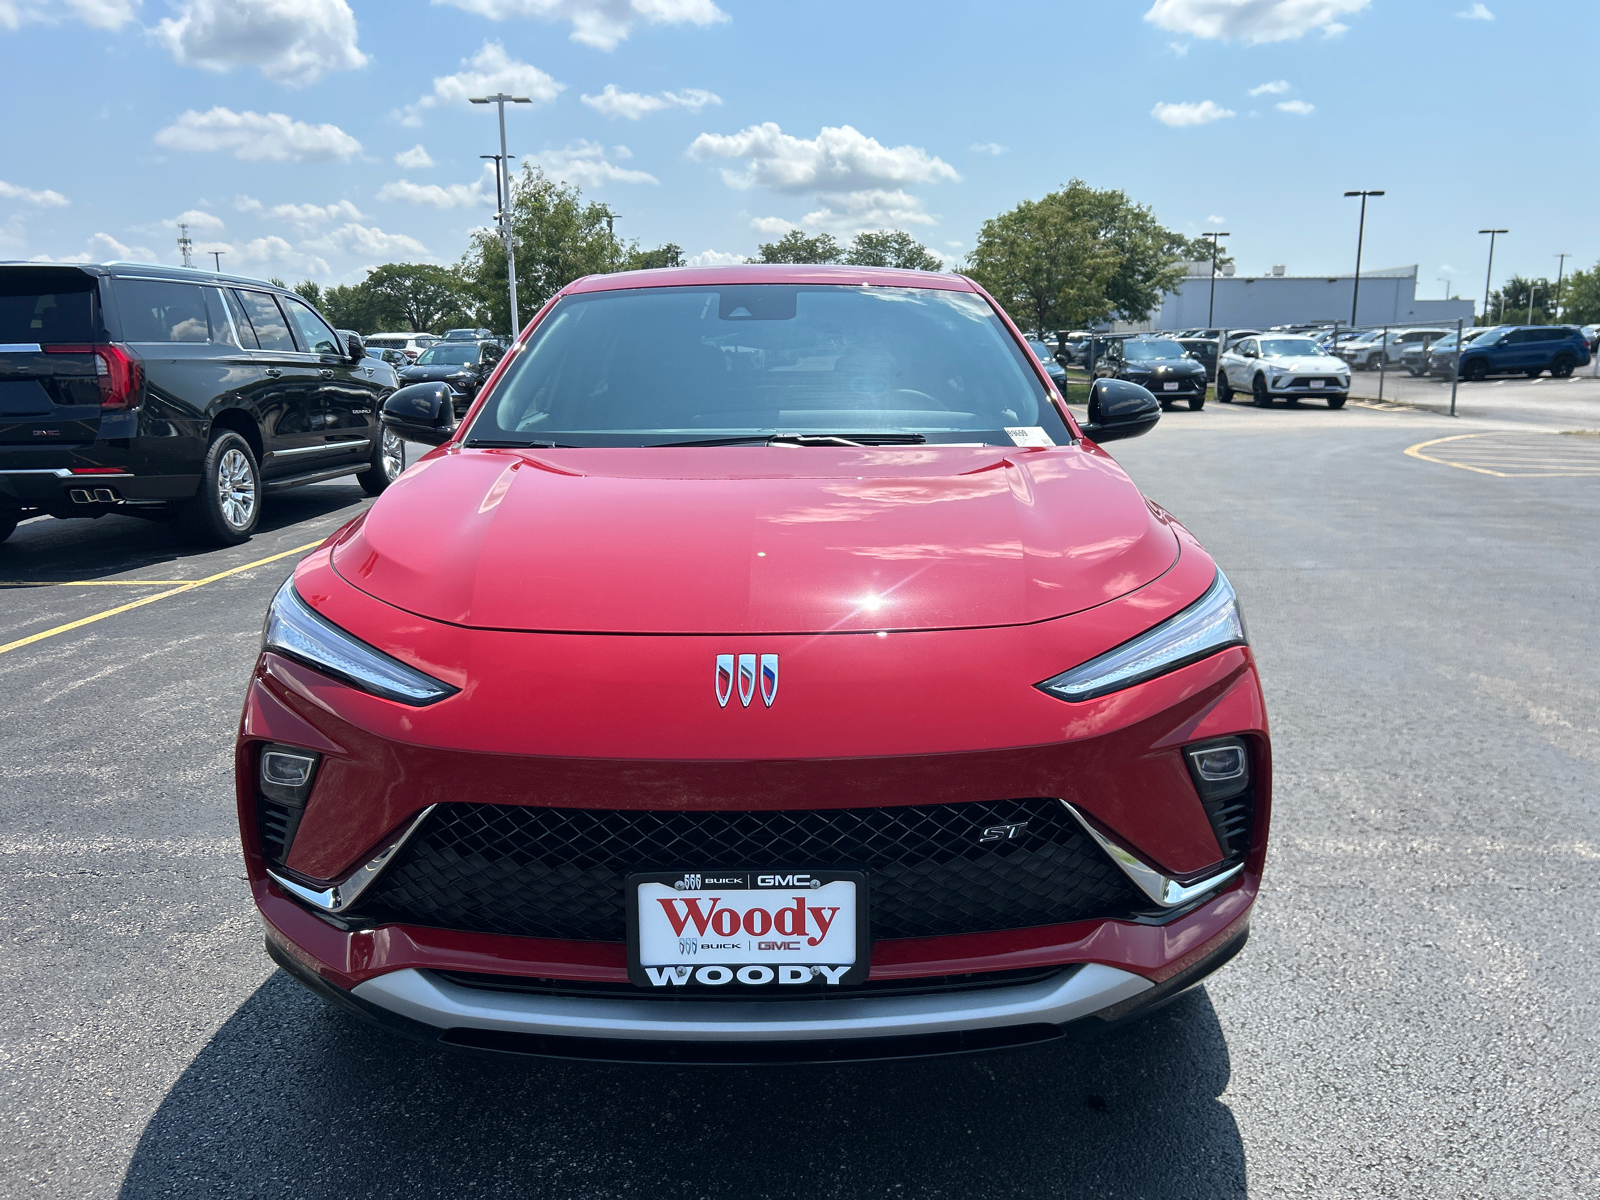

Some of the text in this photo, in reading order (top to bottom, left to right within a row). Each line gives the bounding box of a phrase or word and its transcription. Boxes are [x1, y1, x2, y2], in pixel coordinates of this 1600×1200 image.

[980, 822, 1028, 842] ST
[757, 874, 811, 886] GMC
[656, 897, 840, 947] Woody
[758, 941, 801, 951] GMC
[645, 965, 851, 986] WOODY
